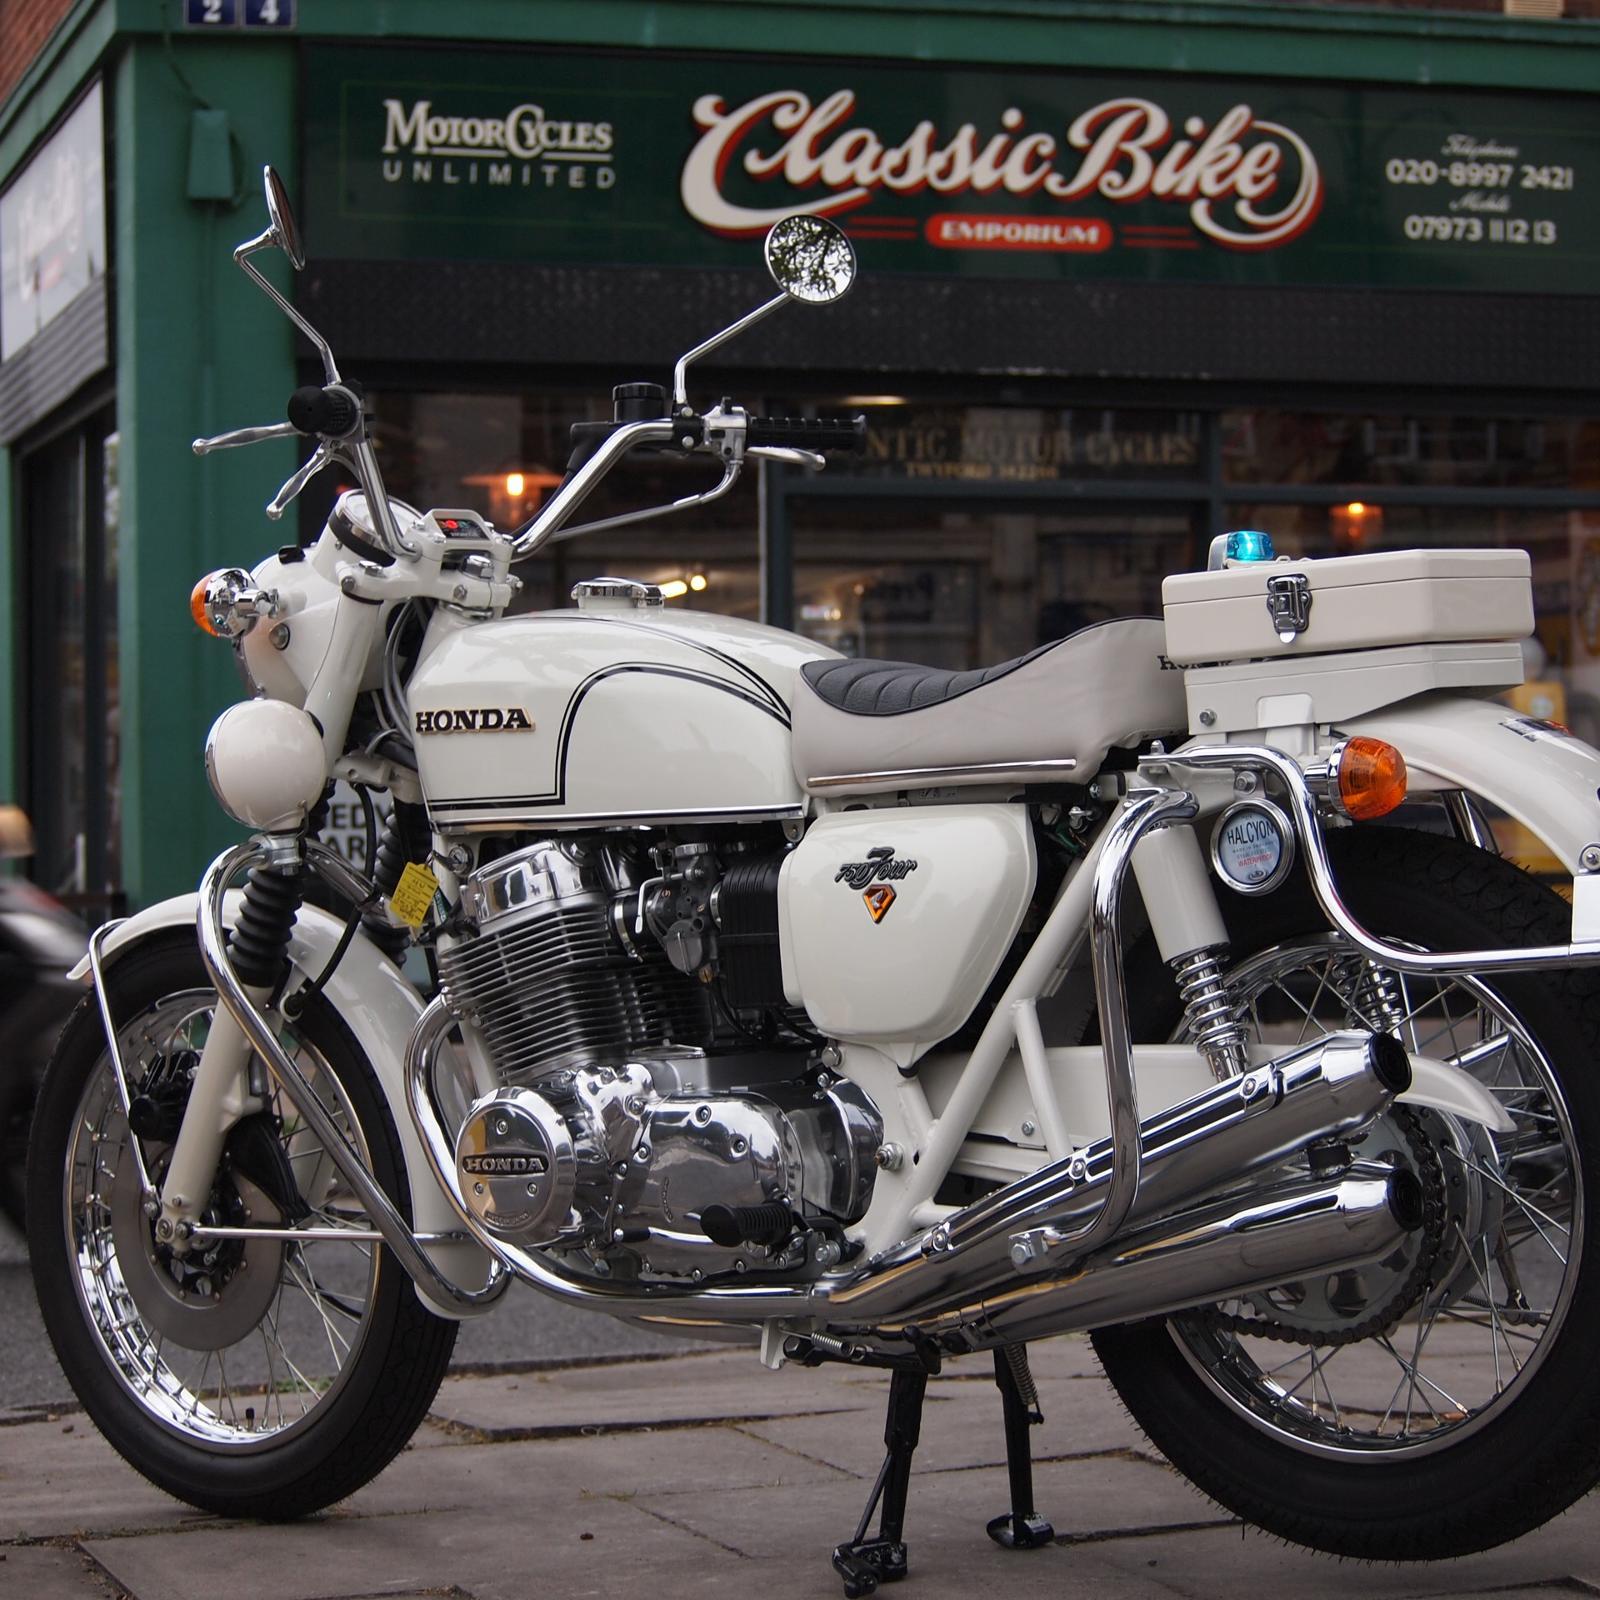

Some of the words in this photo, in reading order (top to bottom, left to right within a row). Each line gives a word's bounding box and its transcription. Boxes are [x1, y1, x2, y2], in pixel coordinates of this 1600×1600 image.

[382, 159, 616, 189] UNLIMITED
[682, 90, 1057, 238] Classic
[1043, 98, 1321, 251] Bike
[940, 220, 1100, 245] EMPORIUM
[1404, 214, 1484, 242] 07973
[415, 707, 534, 733] HONDA
[1226, 820, 1275, 846] HALCYON
[465, 1156, 545, 1173] HONDA
